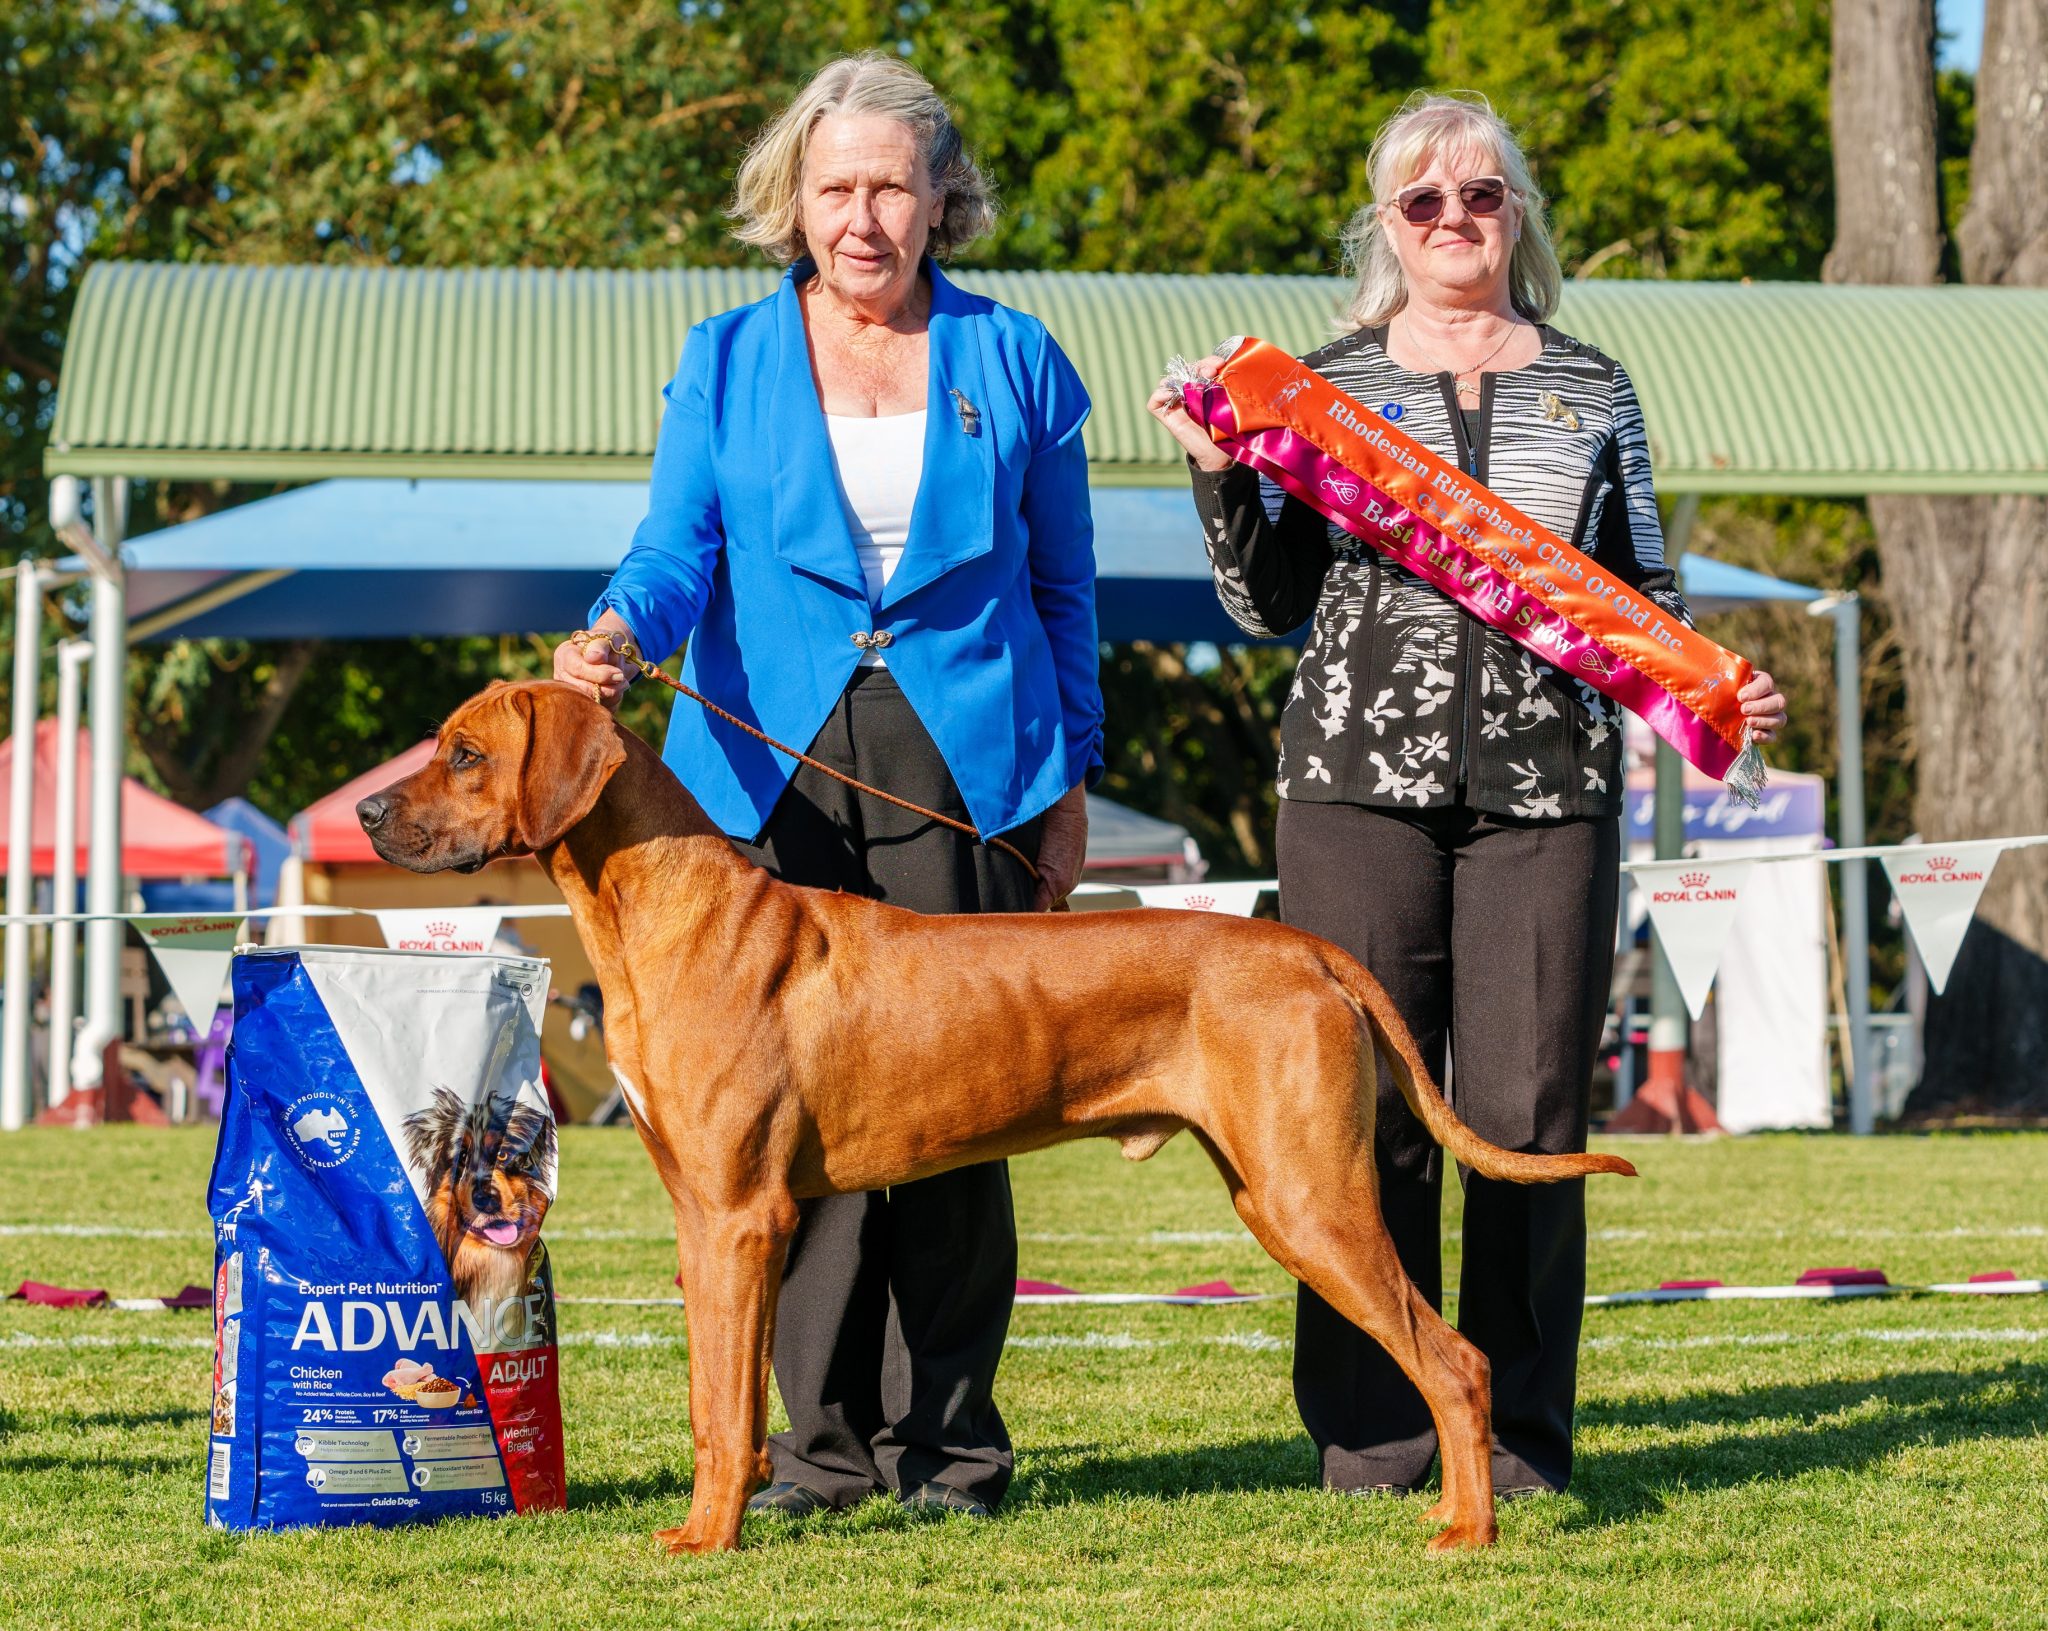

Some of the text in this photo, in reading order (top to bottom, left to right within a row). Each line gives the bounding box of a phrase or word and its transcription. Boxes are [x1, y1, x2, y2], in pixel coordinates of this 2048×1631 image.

[1326, 400, 1683, 655] Rhodesian Ridgeback Club Of Qld Inc.
[1417, 493, 1524, 572] Champioship
[1360, 499, 1576, 655] Best Junior In Show
[1900, 871, 1983, 883] ROYAL CANIN
[1653, 889, 1736, 903] ROYAL CANIN
[150, 921, 235, 936] ROYAL CANIN
[399, 940, 483, 951] ROYAL CANIN
[284, 1092, 359, 1121] MADE PROUDLY IN THE
[286, 1127, 307, 1158] CENTRAL
[352, 1128, 361, 1146] NSW
[299, 1283, 345, 1297] Expert
[349, 1283, 372, 1294] Pet
[291, 1293, 543, 1351] ADVANCE
[290, 1366, 342, 1379] Chicken
[488, 1356, 548, 1384] ADULT
[292, 1380, 333, 1389] with Rice
[302, 1408, 333, 1423] 24%
[372, 1409, 398, 1423] 17%
[503, 1425, 539, 1440] Medium
[508, 1439, 534, 1453] Breed
[371, 1498, 396, 1507] Guide
[480, 1491, 507, 1505] 15 kg
